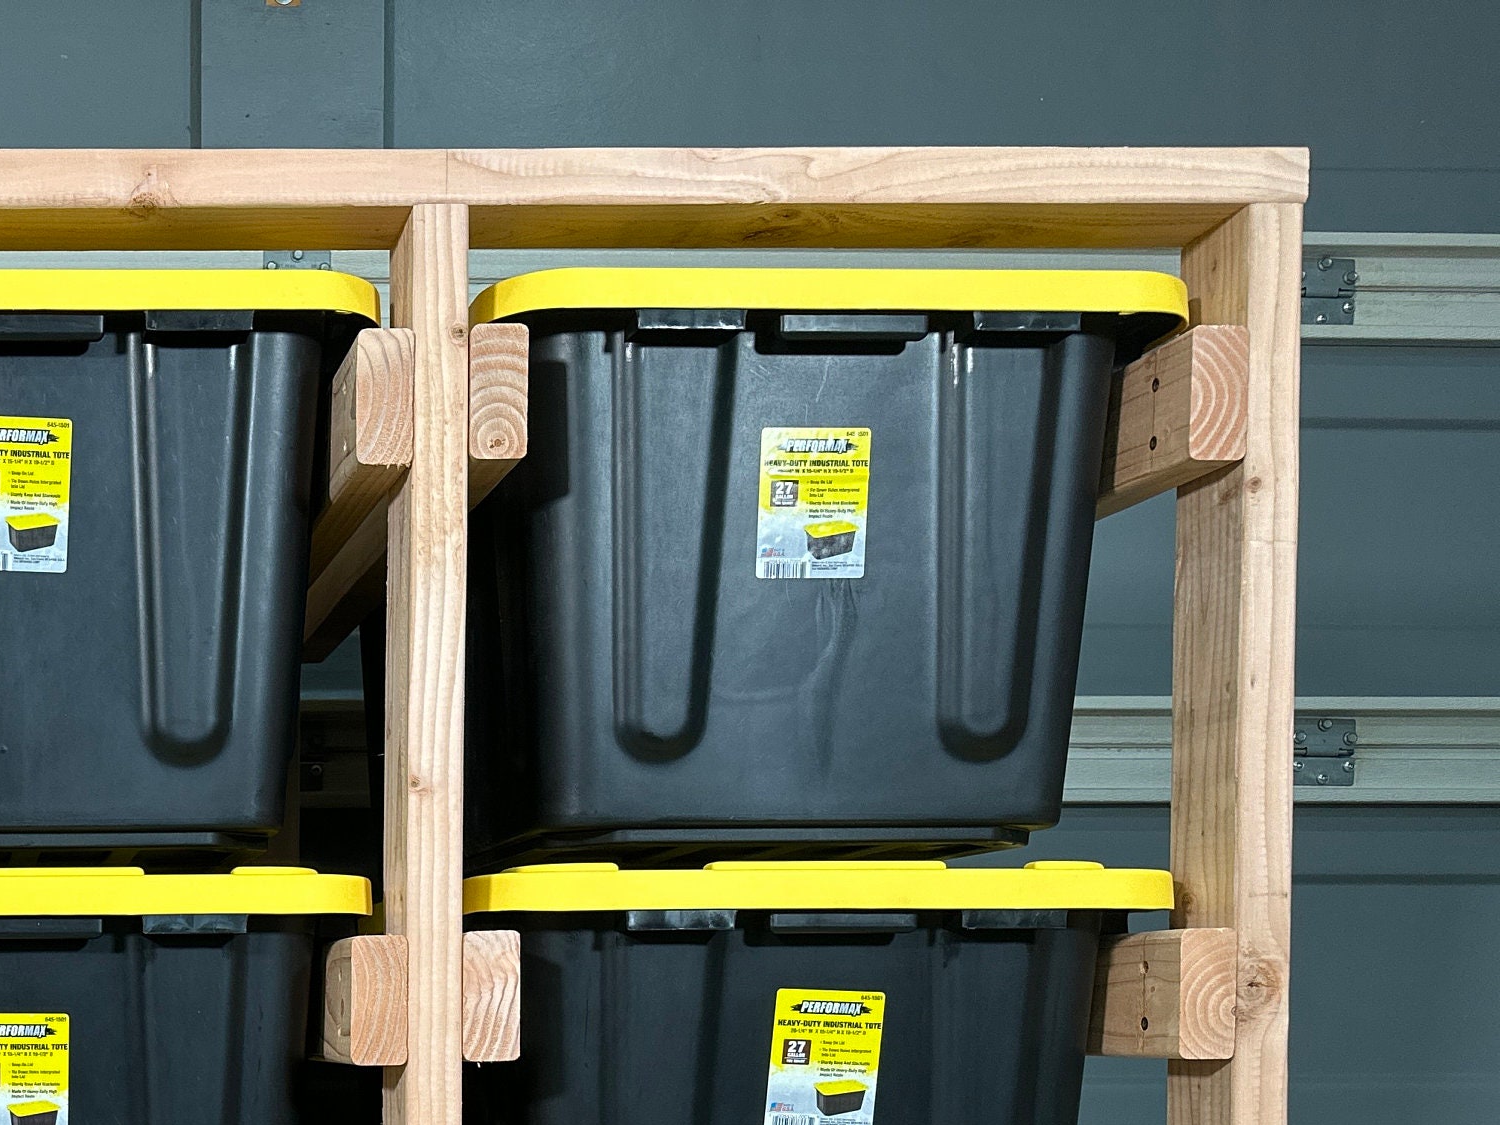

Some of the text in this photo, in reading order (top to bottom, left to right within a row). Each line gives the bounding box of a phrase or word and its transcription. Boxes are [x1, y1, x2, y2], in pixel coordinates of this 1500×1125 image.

[786, 440, 847, 453] PERFORMAX
[11, 450, 51, 458] INDUSTRIAL
[53, 451, 69, 459] TOTE
[775, 482, 793, 494] 27
[801, 1001, 862, 1016] PERFORMAX
[778, 1019, 821, 1027] HEAVY-DUTY
[788, 1040, 806, 1053] 27
